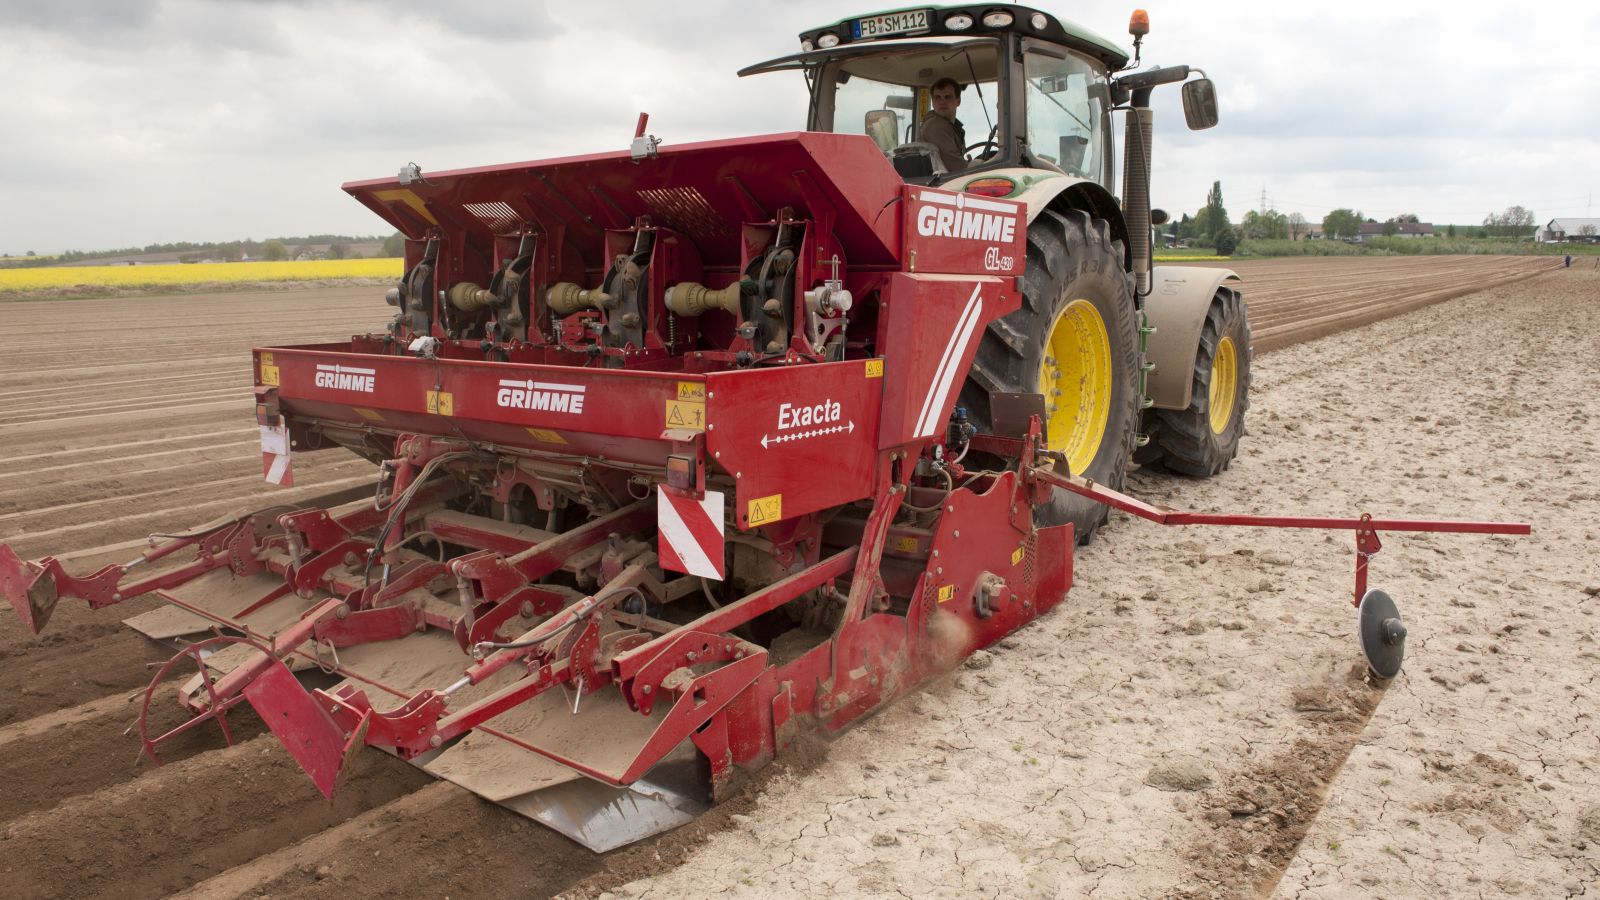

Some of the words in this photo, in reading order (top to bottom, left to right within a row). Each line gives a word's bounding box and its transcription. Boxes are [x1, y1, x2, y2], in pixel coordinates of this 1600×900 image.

[917, 194, 1017, 243] GRIMME
[985, 246, 1000, 271] GL
[1000, 256, 1014, 271] 420
[315, 364, 376, 393] GRIMME
[497, 379, 585, 415] GRIMME
[778, 398, 841, 430] Exacta
